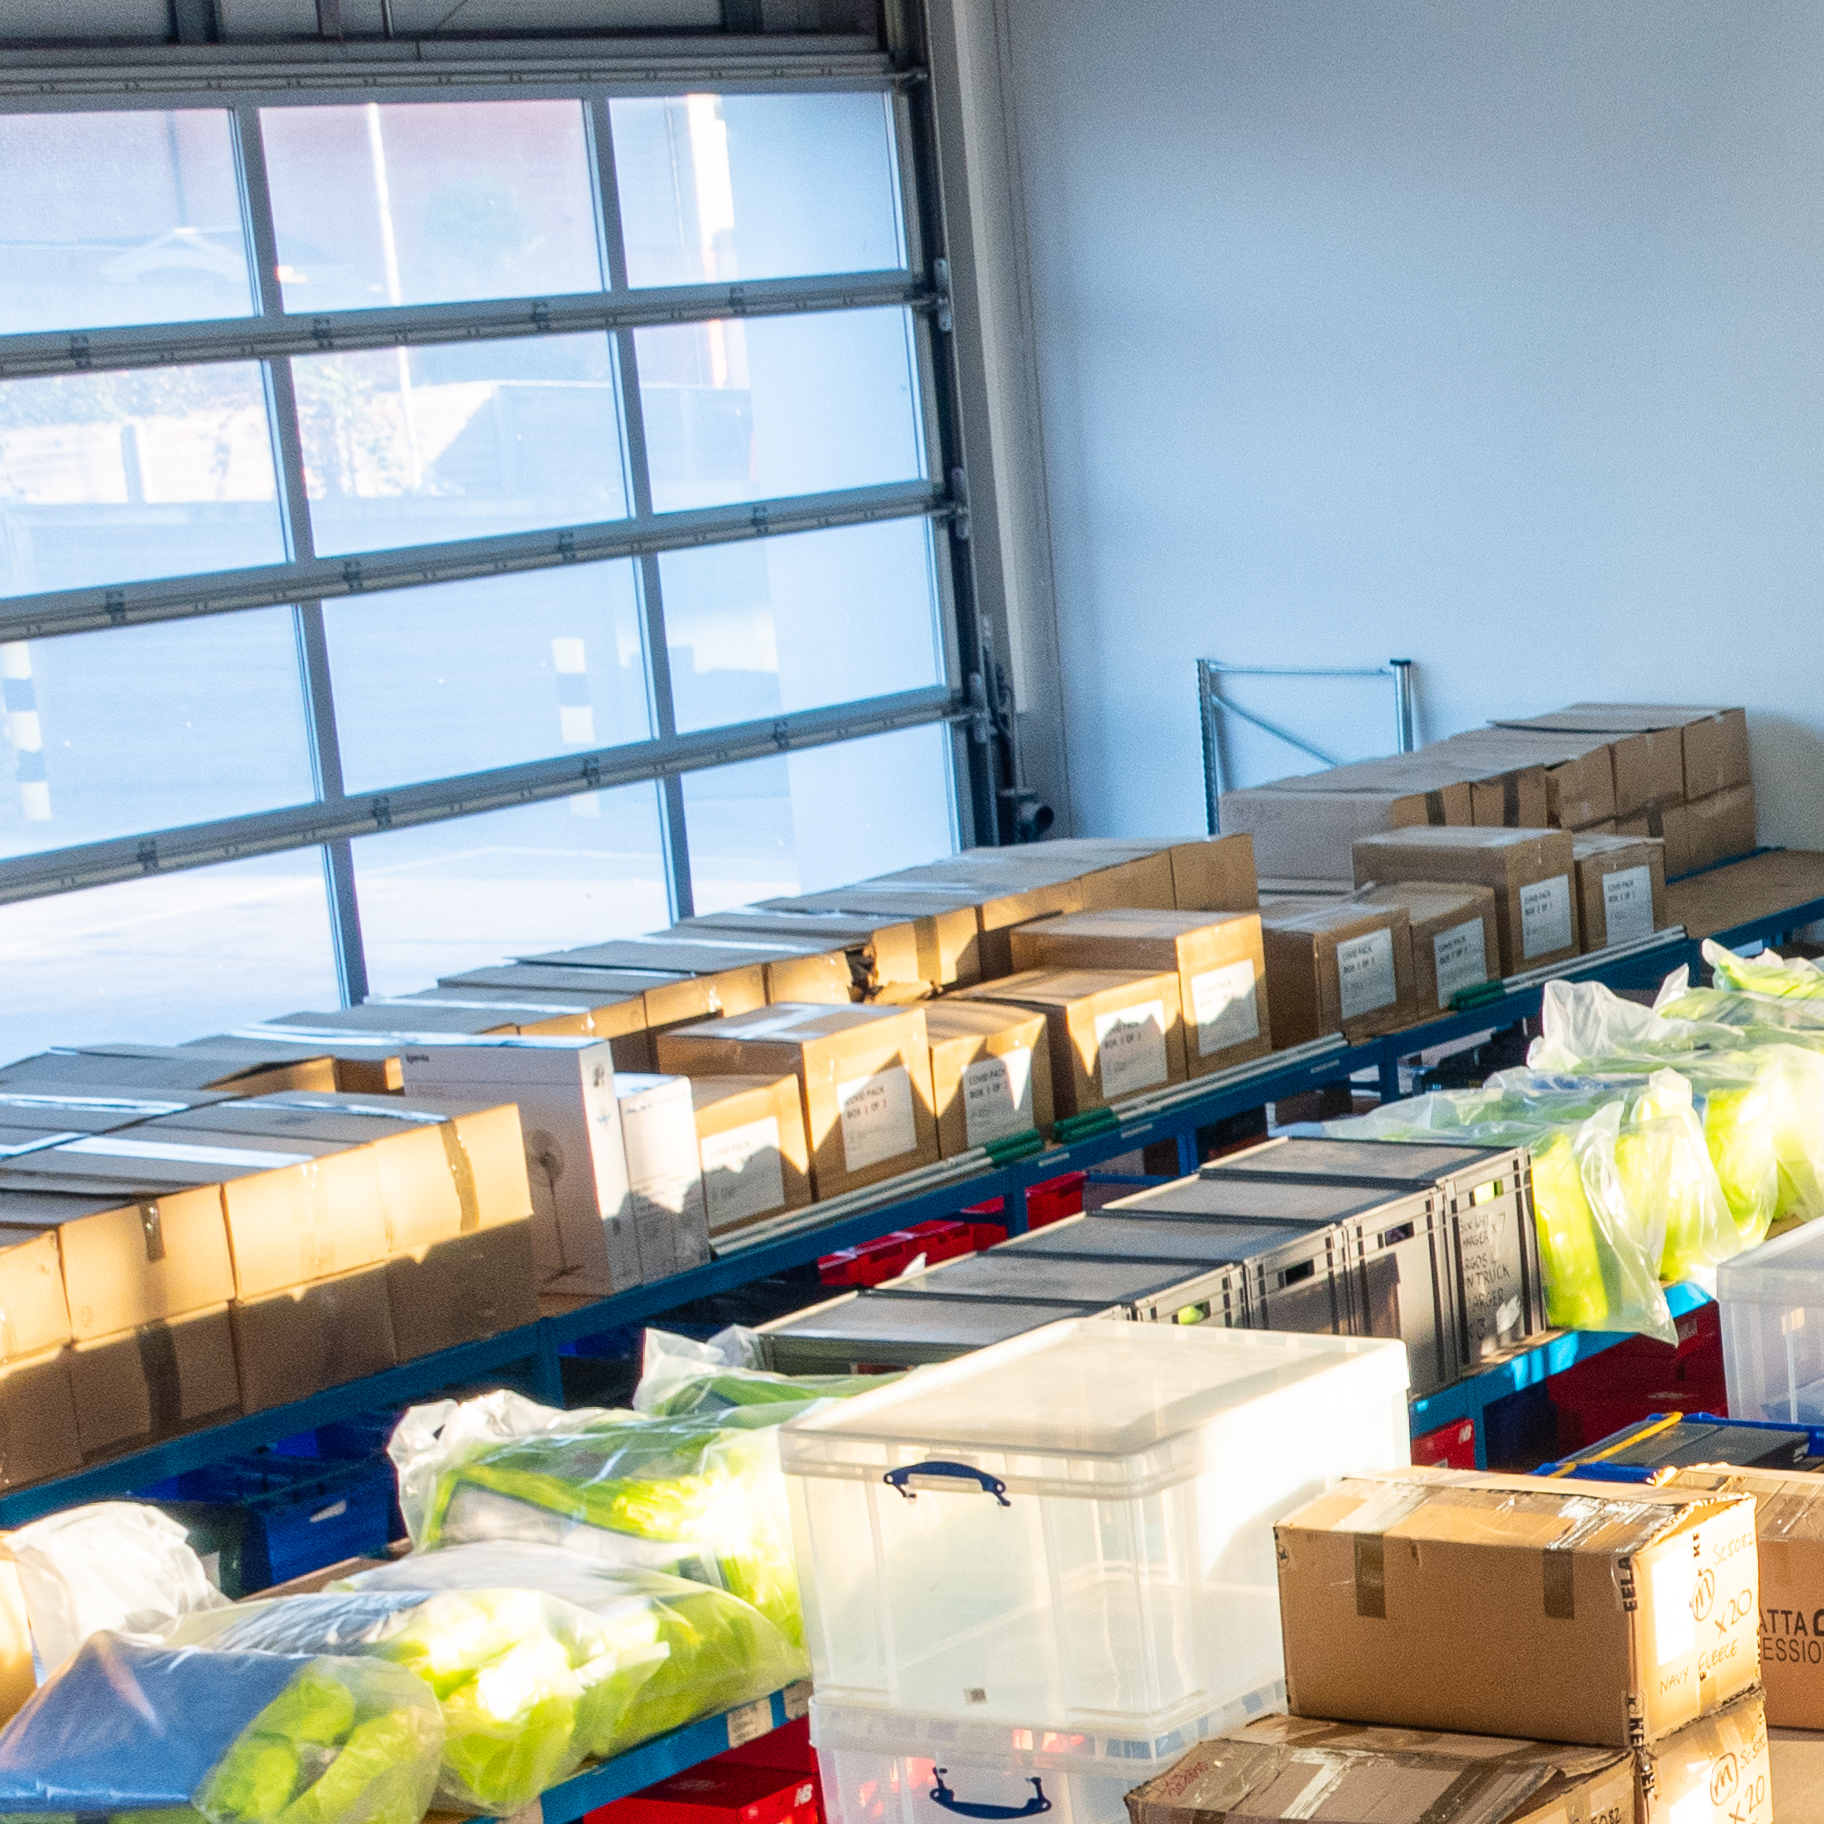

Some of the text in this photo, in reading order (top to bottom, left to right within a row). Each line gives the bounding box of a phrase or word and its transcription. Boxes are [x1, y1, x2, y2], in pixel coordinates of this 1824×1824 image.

[1759, 1609, 1809, 1638] ATTA
[1659, 1639, 1739, 1695] NAVY FLEECE
